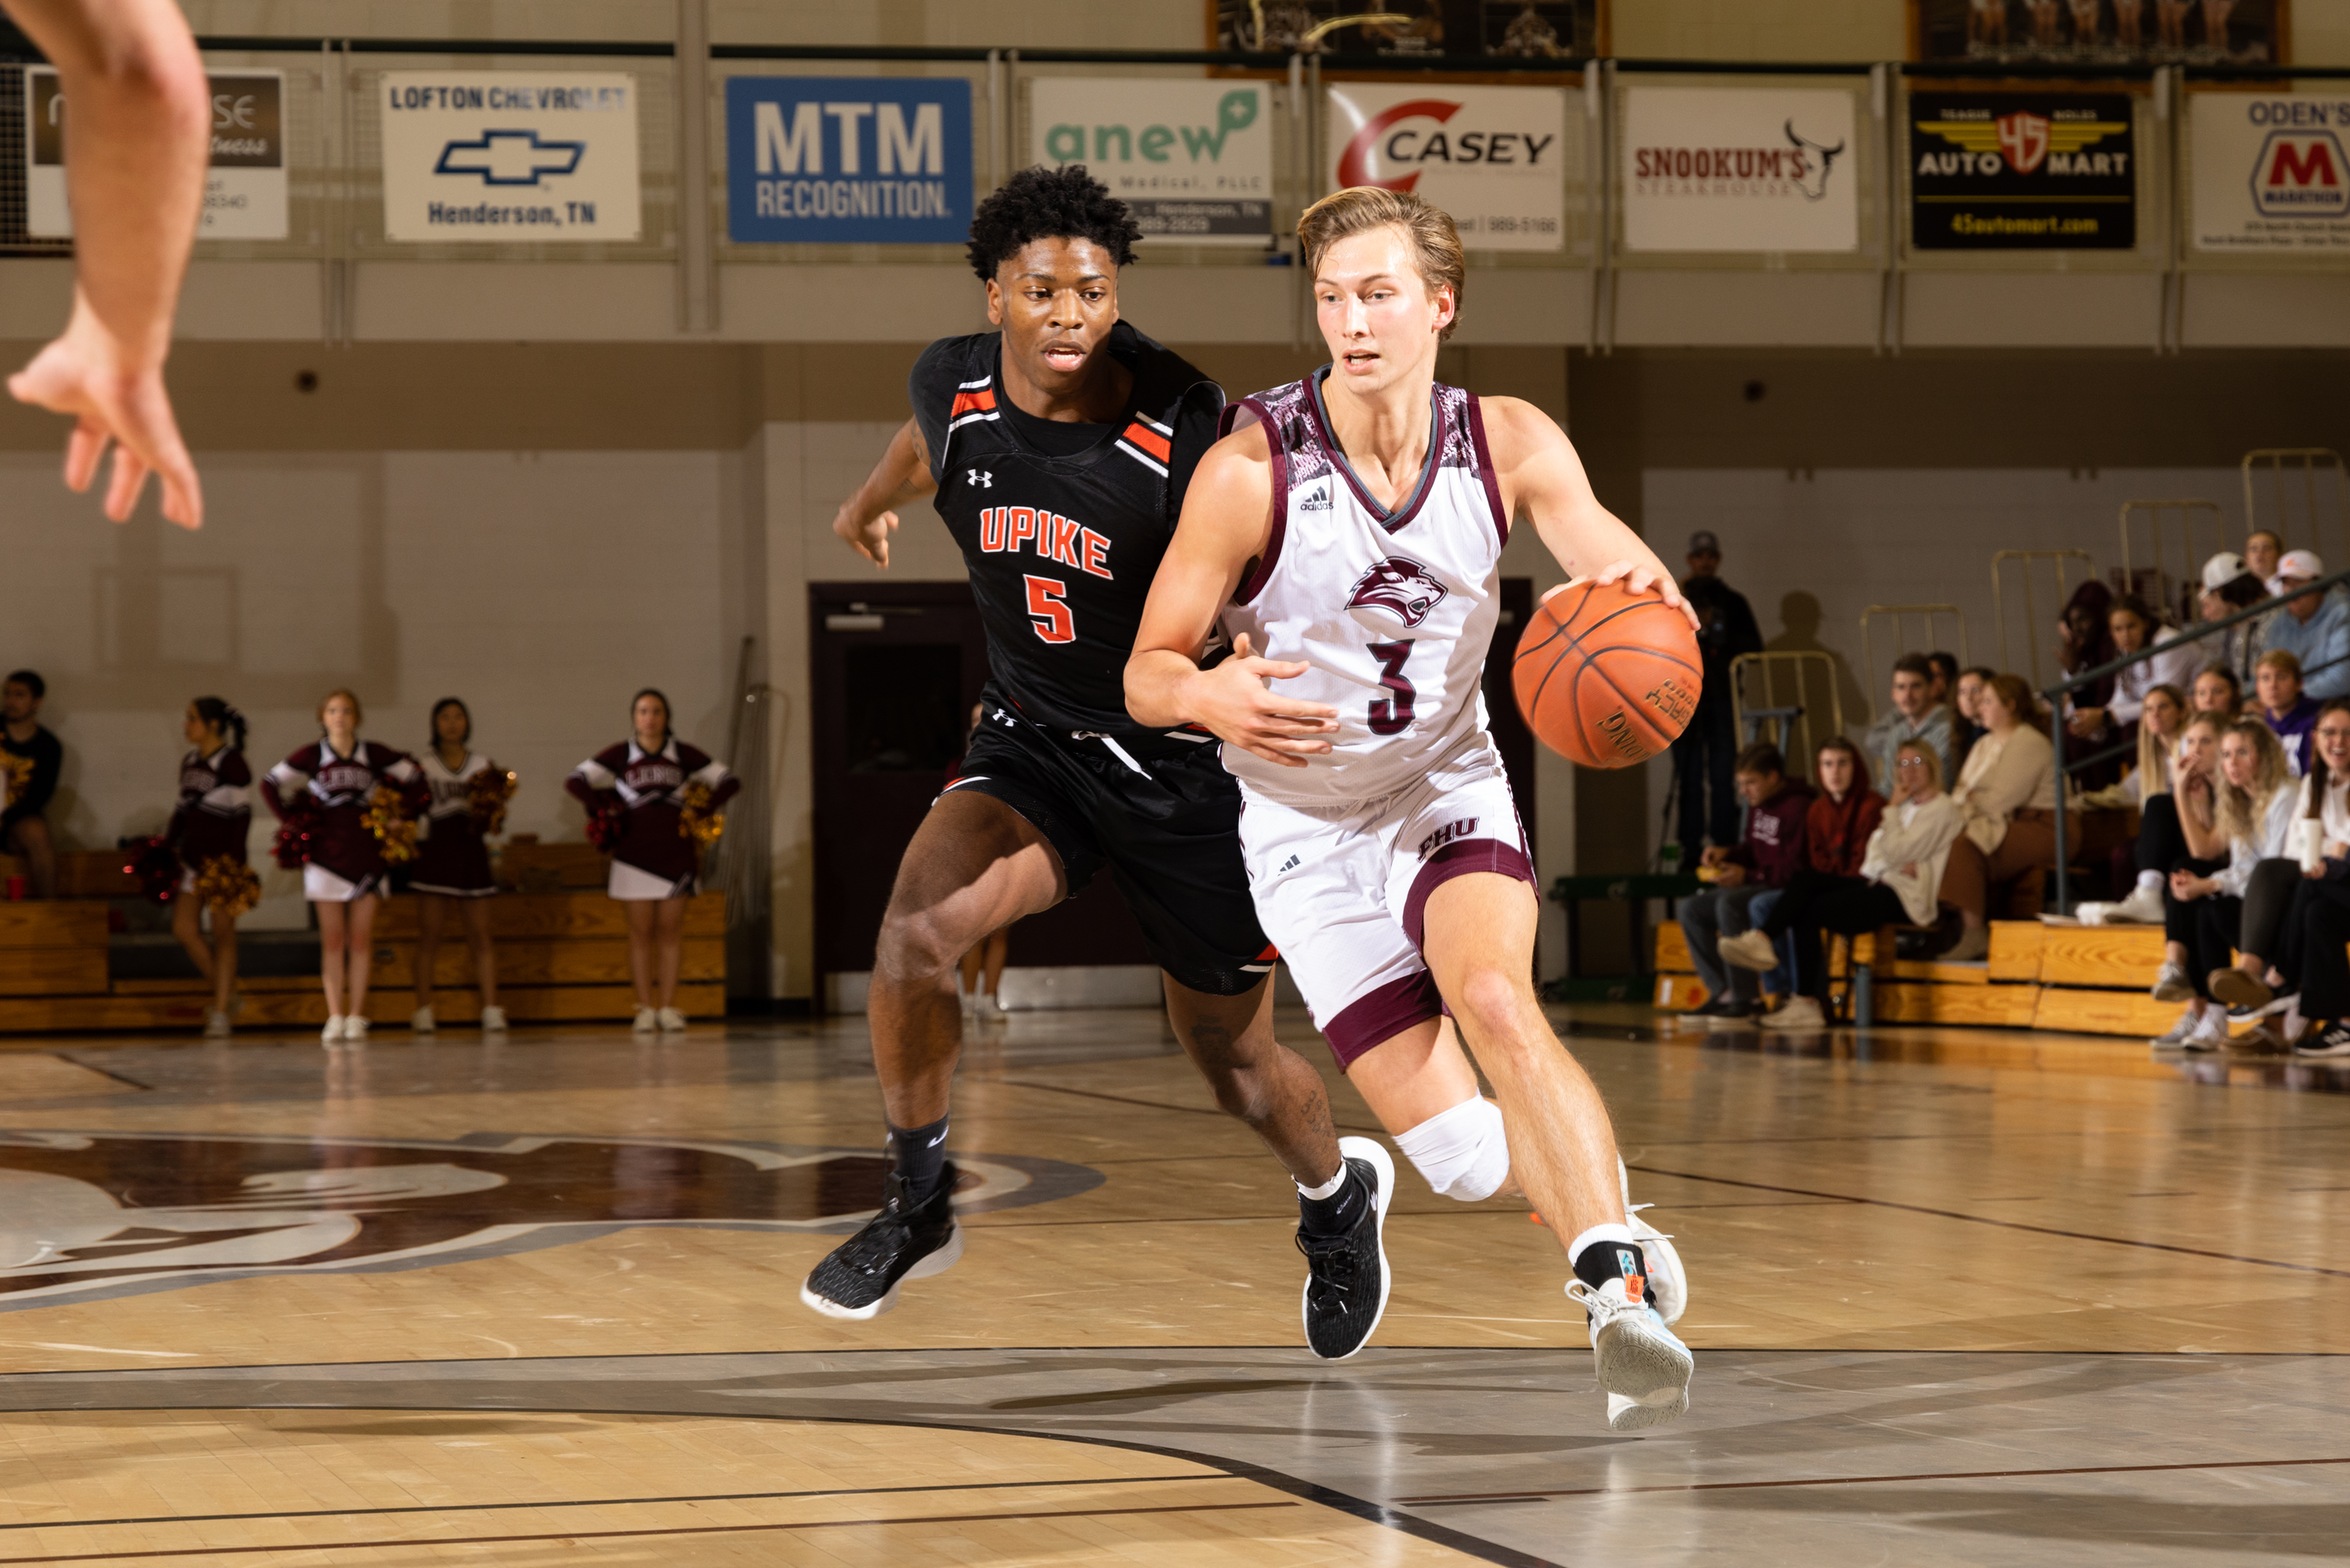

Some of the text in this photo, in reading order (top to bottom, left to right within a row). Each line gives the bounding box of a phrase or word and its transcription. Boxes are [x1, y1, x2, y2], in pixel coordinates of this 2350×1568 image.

[390, 86, 626, 111] LOFTON CHEVROLET
[2249, 102, 2350, 127] ODEN'S
[754, 101, 944, 175] MTM
[1045, 120, 1230, 162] anew
[1387, 131, 1555, 164] CASEY
[1998, 116, 2050, 171] 45
[1636, 147, 1806, 178] SNOOKUM'S
[1917, 152, 2129, 176] AUTO MART
[1635, 180, 1791, 196] STEAKHOUSE
[2264, 190, 2342, 204] MARATHON
[428, 201, 596, 226] Henderson, TN
[1951, 213, 2099, 235] 45automart.com
[1300, 500, 1334, 511] adidas
[979, 506, 1114, 581] UPIKE
[1022, 573, 1077, 644] 5
[1366, 638, 1417, 736] 3
[1416, 816, 1480, 864] FHU
